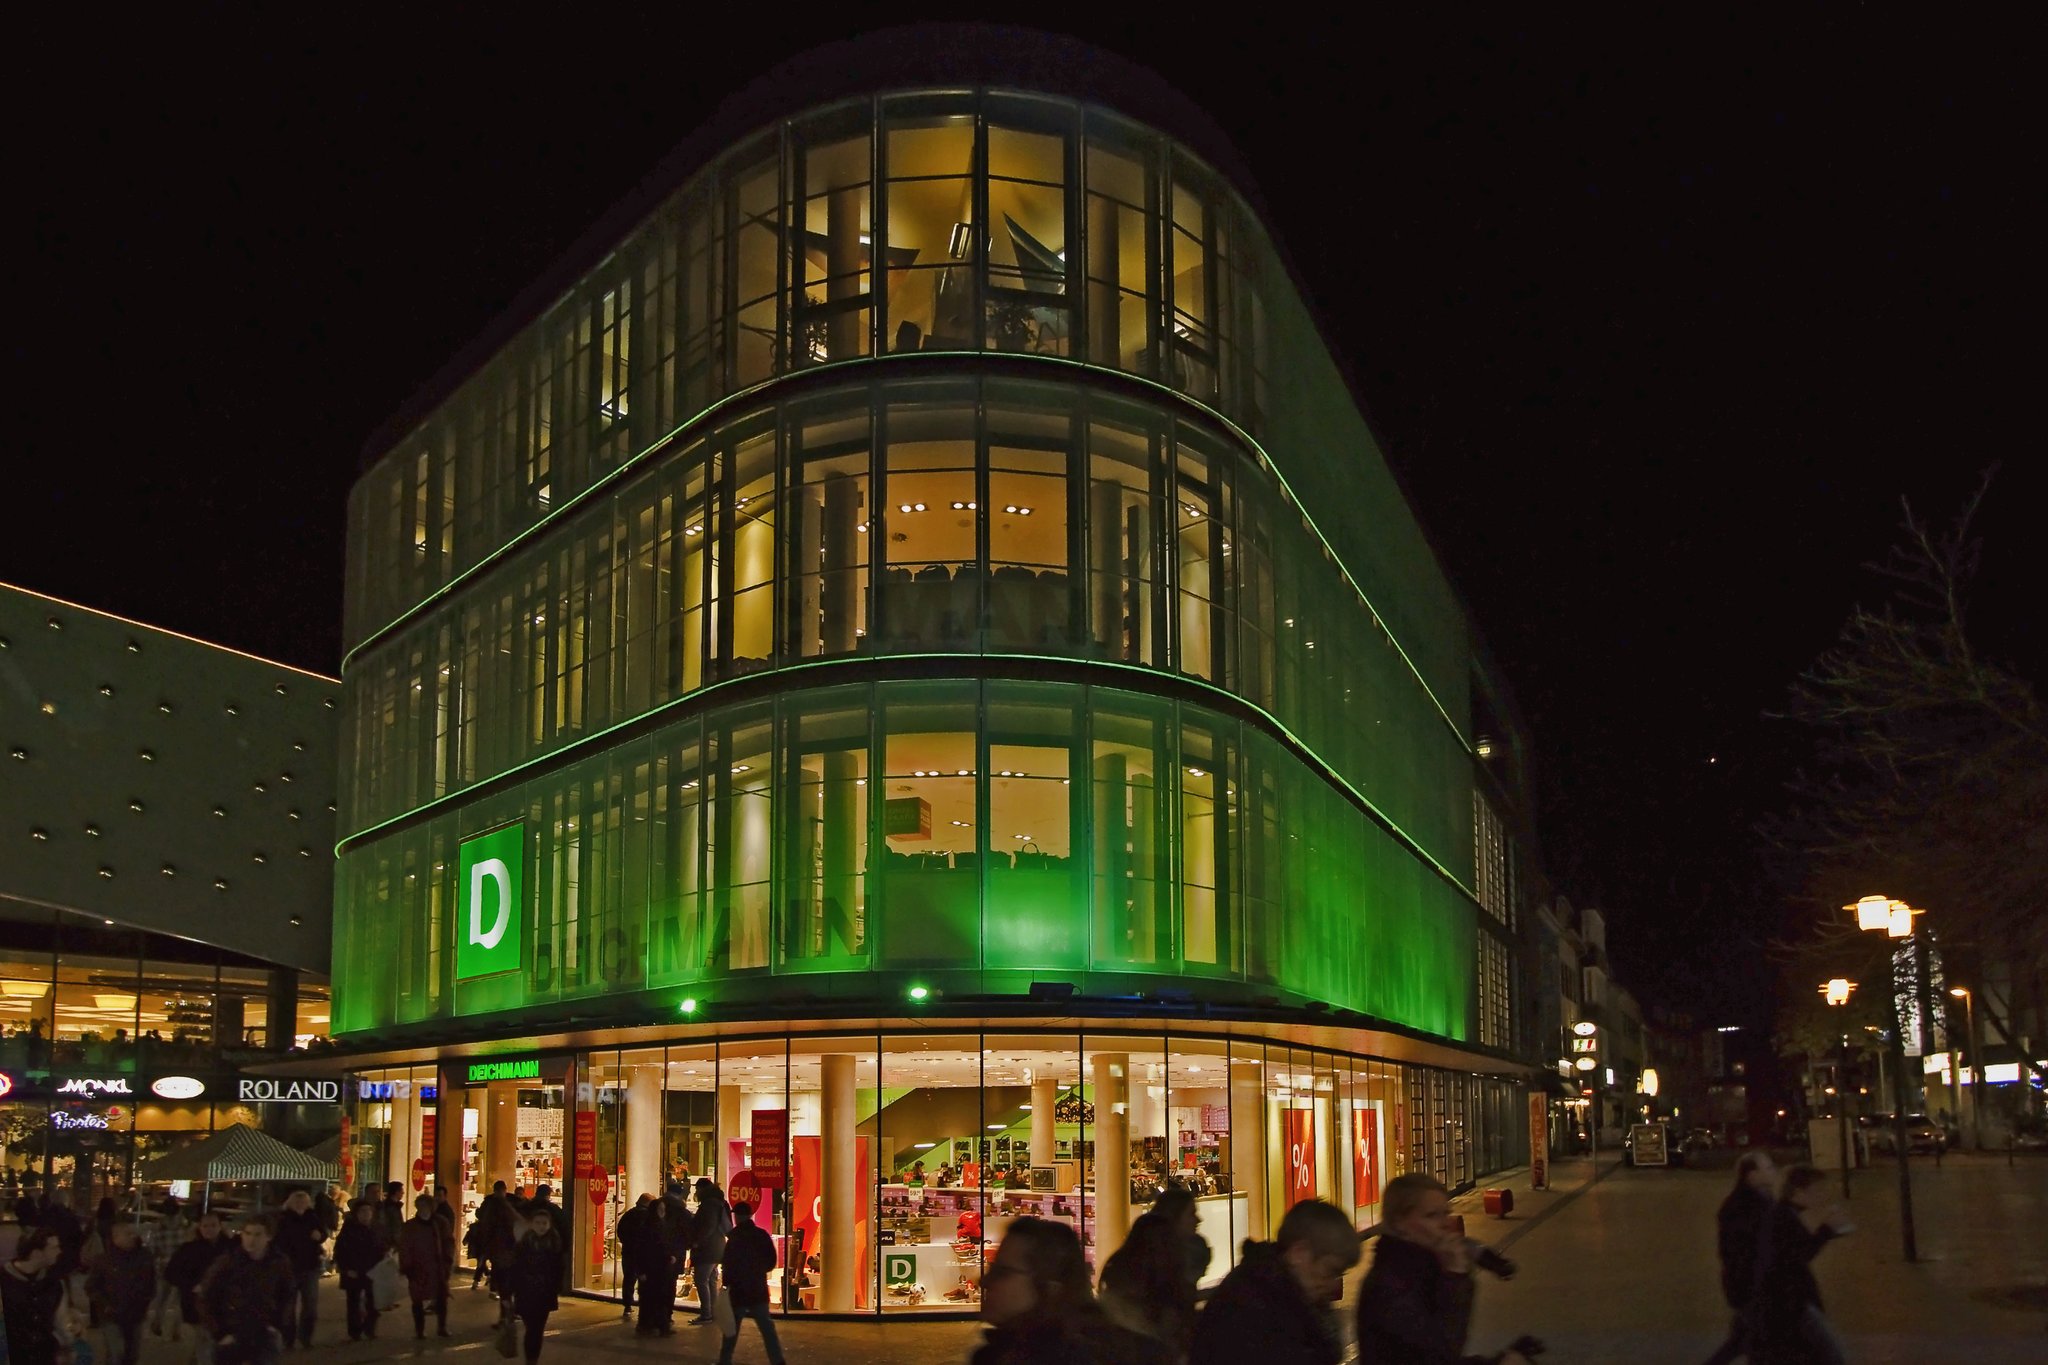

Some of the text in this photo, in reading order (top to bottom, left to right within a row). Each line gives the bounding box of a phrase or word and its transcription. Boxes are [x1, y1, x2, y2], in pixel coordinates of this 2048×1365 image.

[470, 858, 512, 949] D
[468, 1060, 539, 1081] DEICHMANN
[239, 1080, 338, 1099] ROLAND
[577, 1152, 592, 1160] stark
[755, 1156, 780, 1167] stark
[589, 1180, 607, 1192] 50%
[731, 1187, 760, 1201] 50%
[892, 1259, 911, 1279] D
